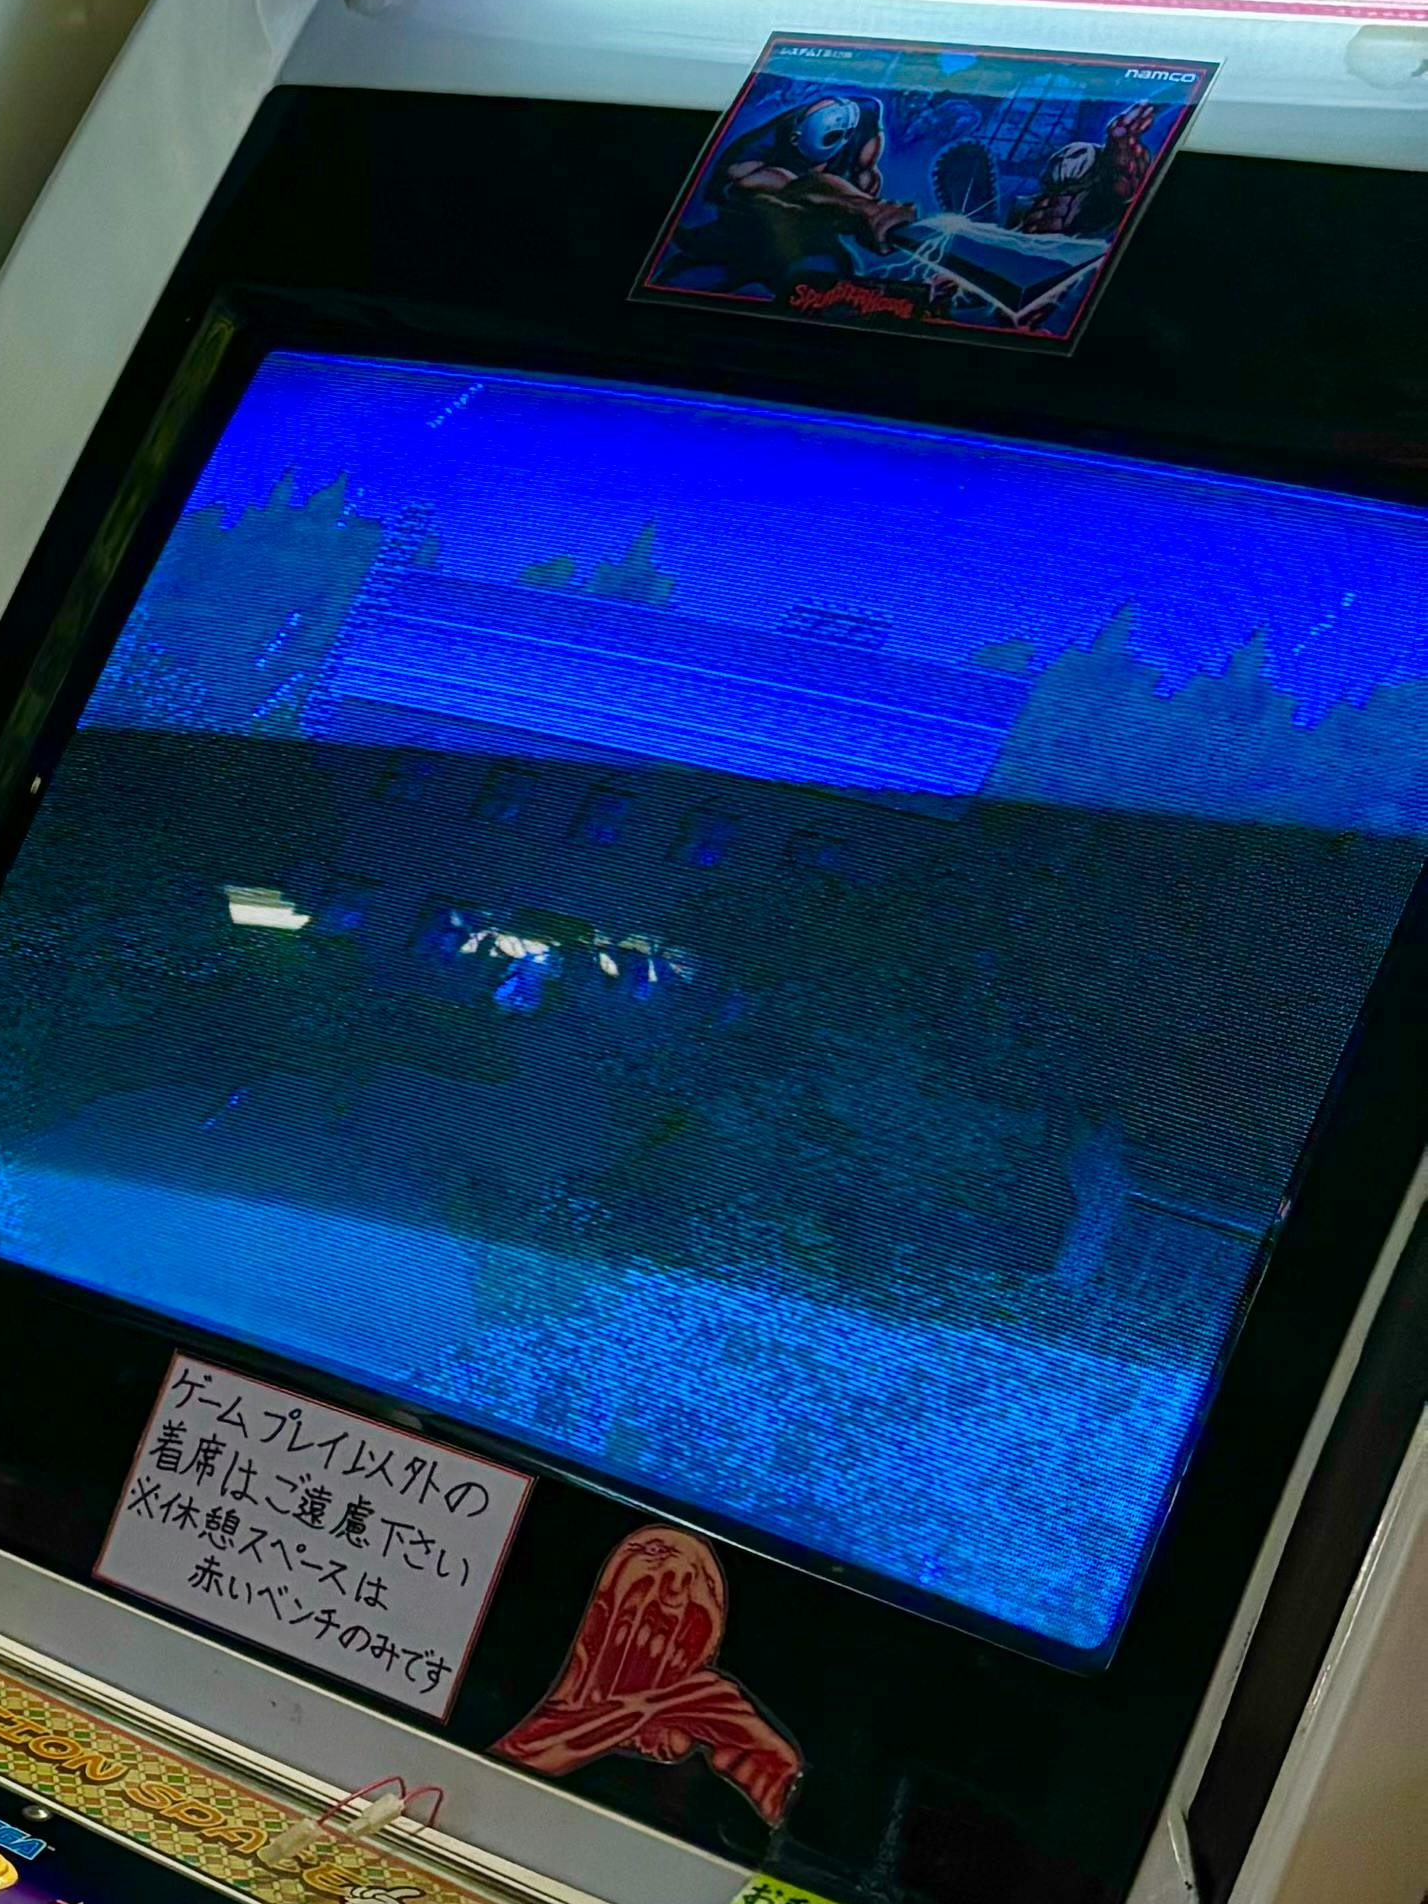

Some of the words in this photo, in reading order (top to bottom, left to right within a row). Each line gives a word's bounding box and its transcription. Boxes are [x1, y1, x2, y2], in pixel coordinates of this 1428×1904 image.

[1124, 68, 1196, 84] namco
[149, 1419, 470, 1587] 着席はご遠慮下さい
[187, 1555, 453, 1695] 赤いベンチのみです
